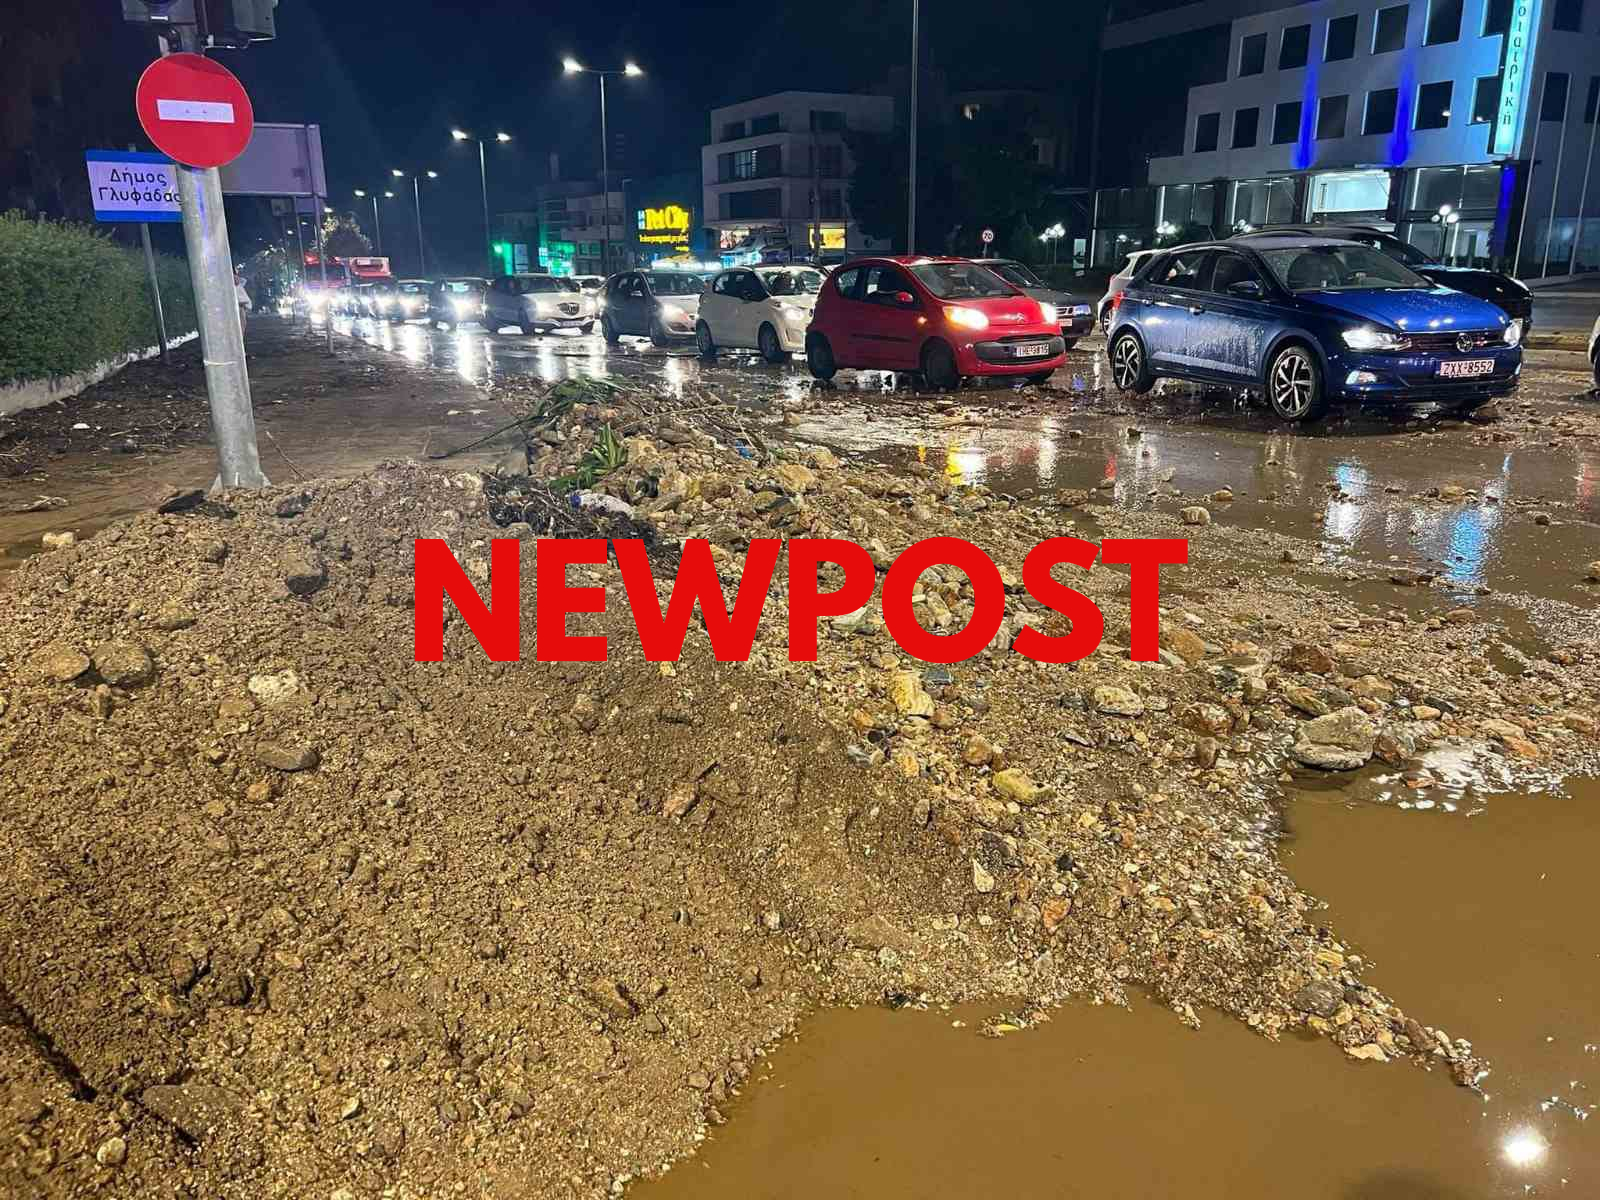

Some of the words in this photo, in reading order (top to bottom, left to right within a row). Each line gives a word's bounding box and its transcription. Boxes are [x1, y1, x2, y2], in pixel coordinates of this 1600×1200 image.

[1503, 0, 1526, 125] οιατρική
[110, 167, 167, 187] Δήμος
[98, 185, 183, 206] Γλυφάδας
